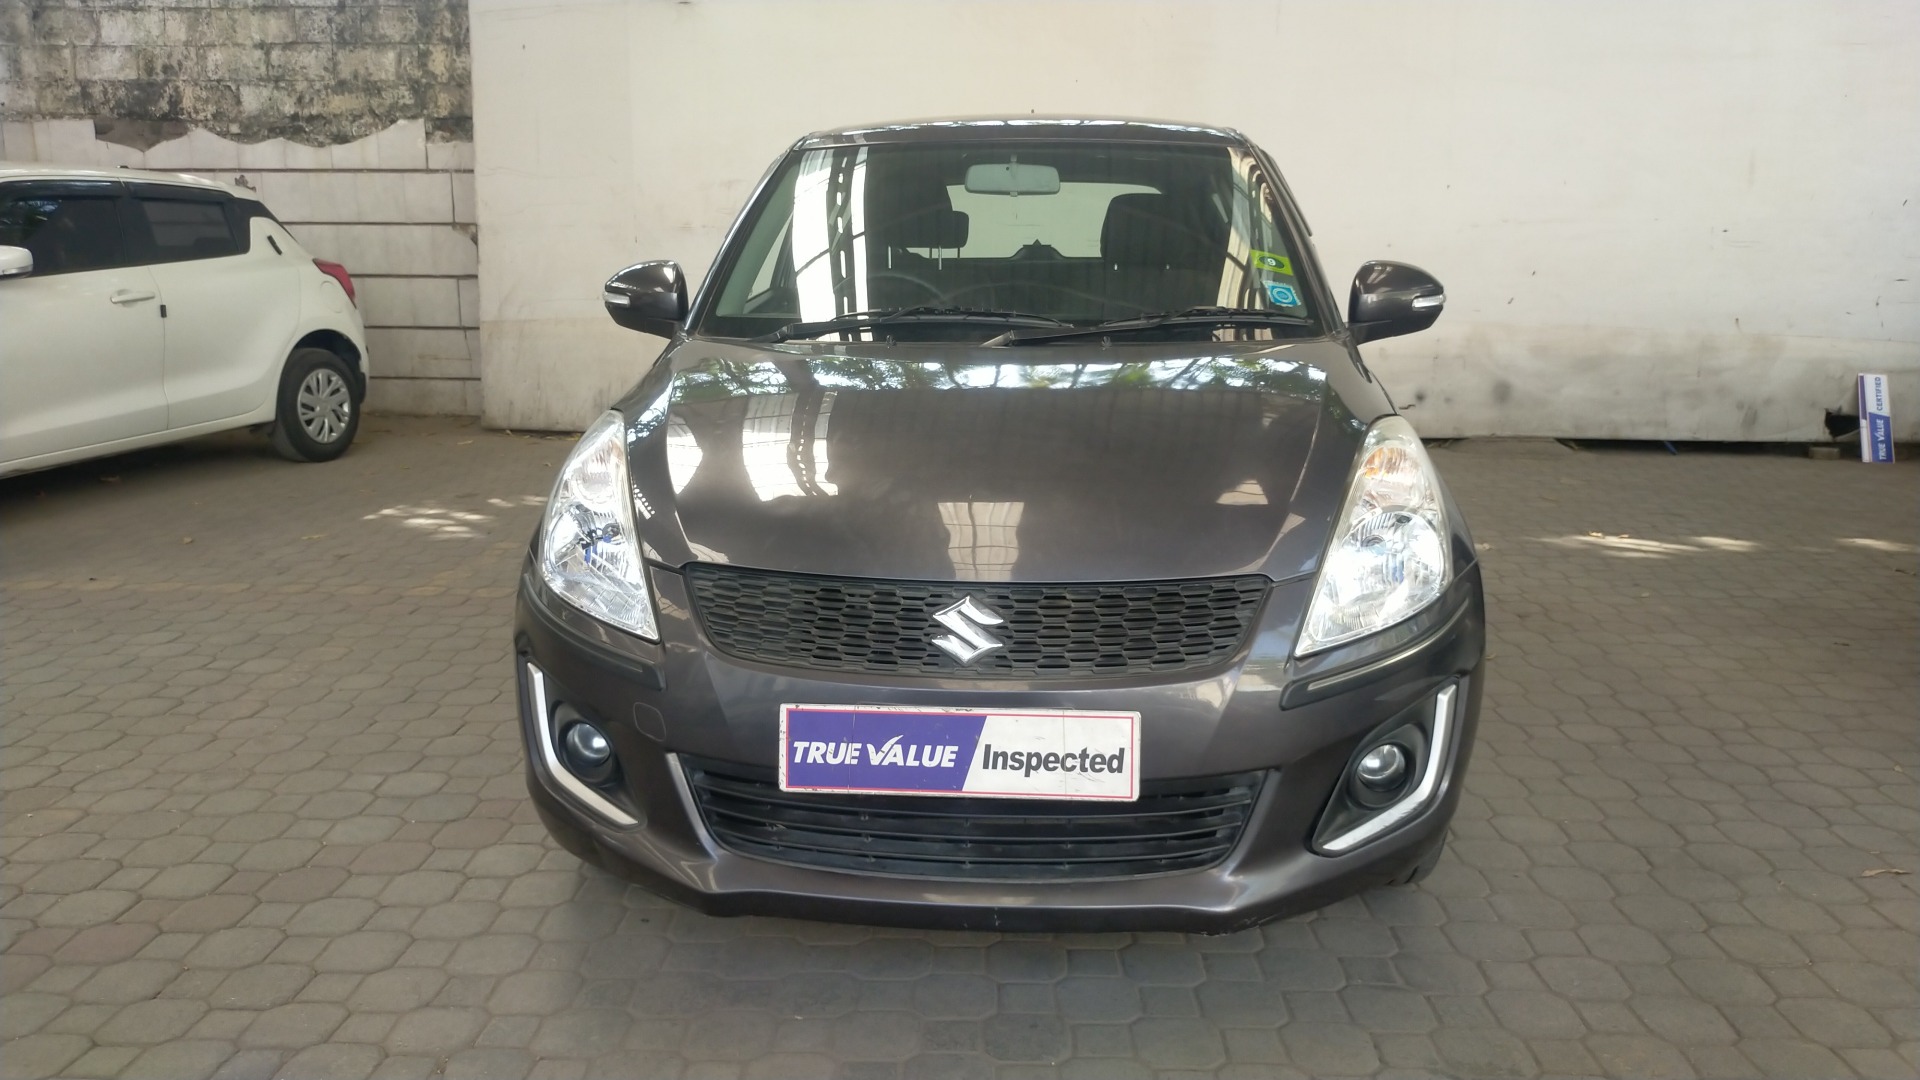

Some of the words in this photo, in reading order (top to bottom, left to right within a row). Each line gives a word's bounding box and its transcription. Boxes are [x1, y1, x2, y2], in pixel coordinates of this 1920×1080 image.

[1875, 376, 1883, 411] CERTIFIED
[1874, 419, 1885, 441] VALUE
[1878, 443, 1887, 460] TRUE
[793, 741, 862, 765] TRUE
[866, 734, 959, 768] VALUE
[982, 743, 1125, 778] Inspected
